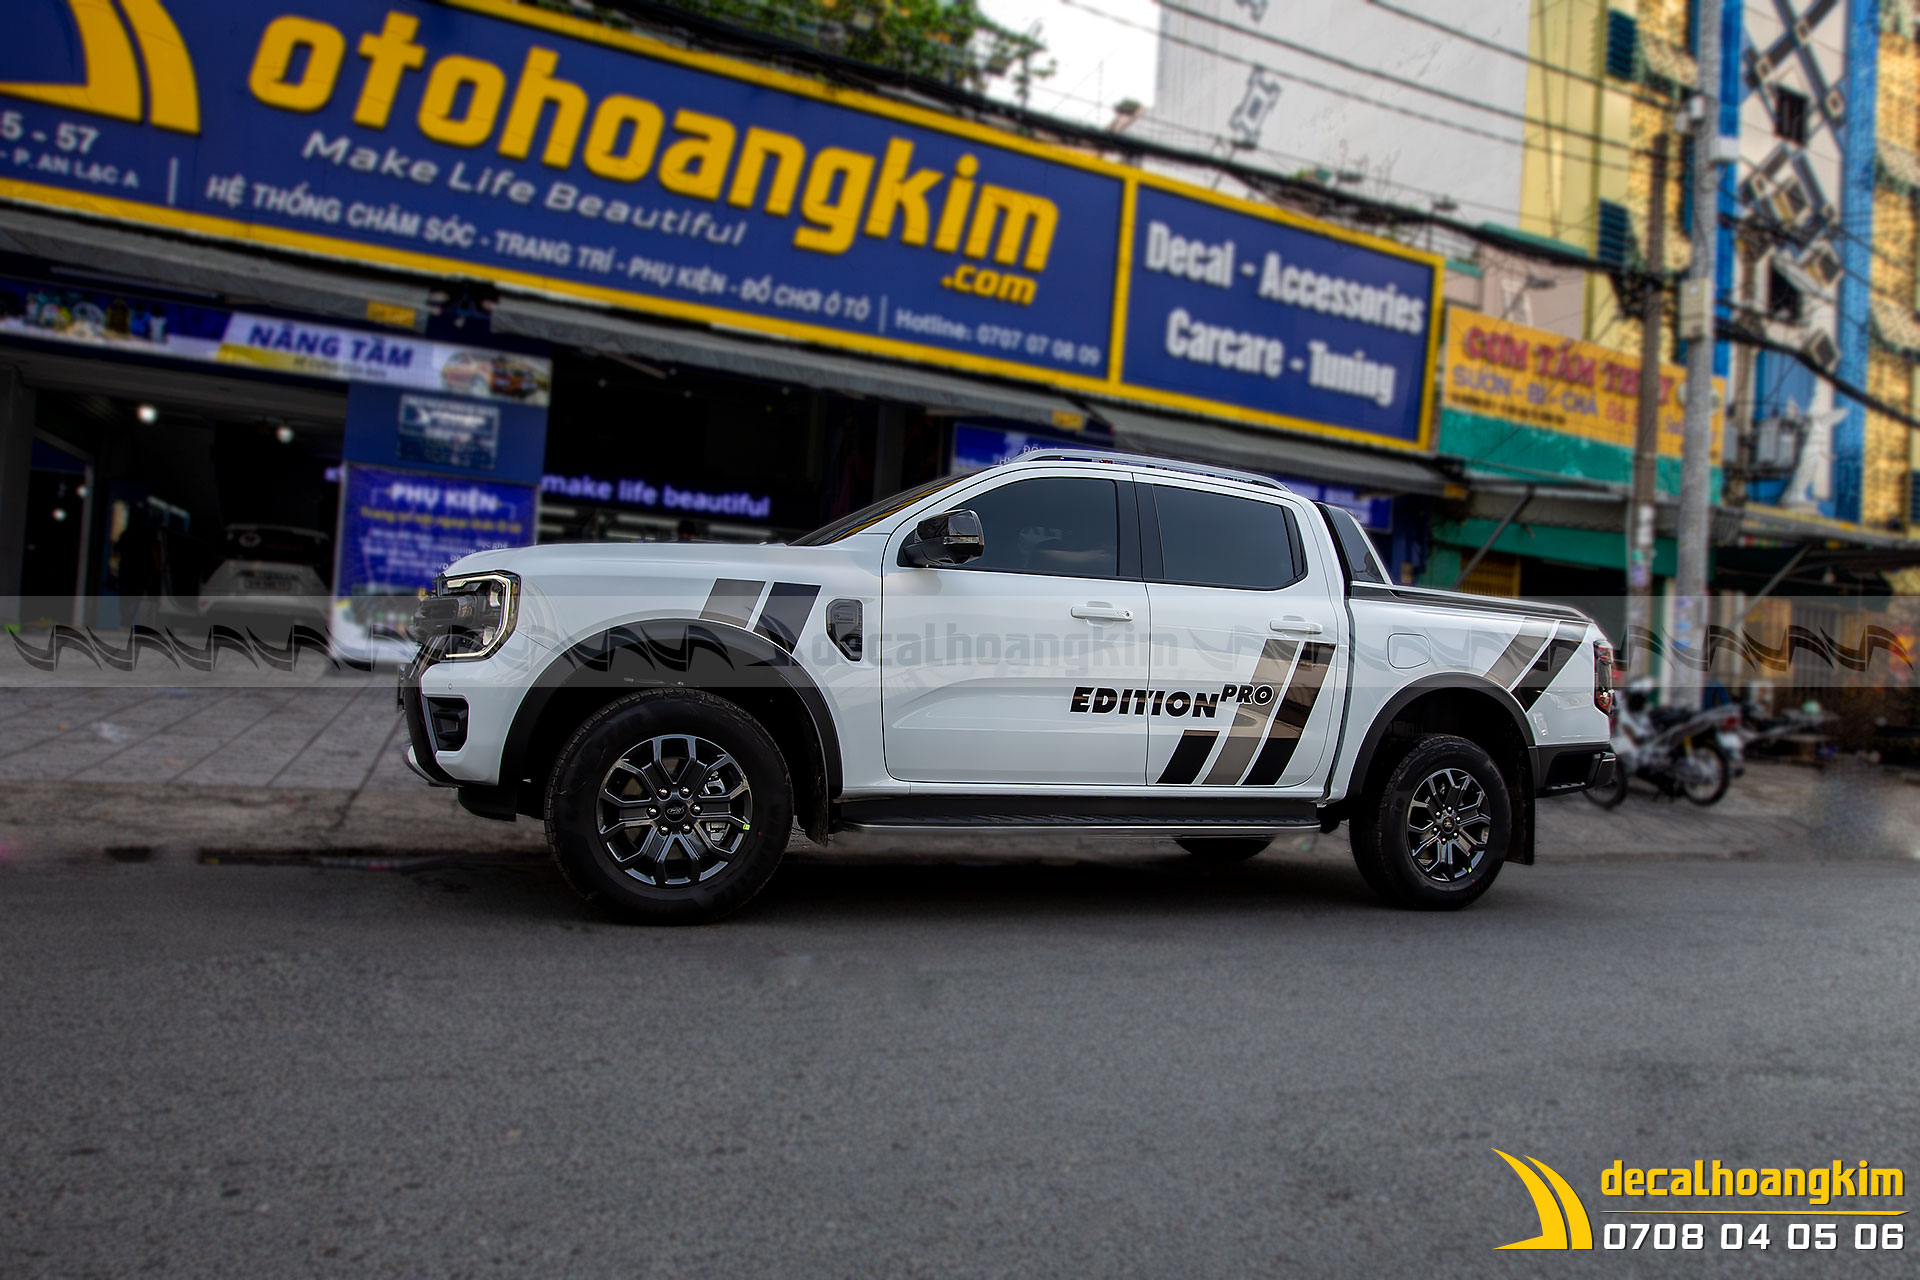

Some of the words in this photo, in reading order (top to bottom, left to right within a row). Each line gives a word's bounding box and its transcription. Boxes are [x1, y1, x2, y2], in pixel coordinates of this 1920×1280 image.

[55, 121, 99, 154] 57
[249, 11, 1058, 271] otohoangkim
[123, 169, 139, 188] A
[303, 132, 438, 183] Make
[448, 161, 536, 205] Life
[544, 181, 746, 246] Beautiful
[206, 174, 246, 208] HỆ
[253, 181, 341, 223] THỐNG
[347, 203, 420, 237] CHĂM
[424, 216, 475, 248] SÓC
[495, 230, 571, 266] TRANG
[576, 247, 616, 273] TRÍ
[628, 256, 673, 288] PHỤ
[676, 266, 727, 294] KIỆN
[940, 264, 1037, 306] .com
[1145, 221, 1234, 287] Decal
[1259, 251, 1424, 335] Accessories
[895, 308, 973, 341] Hotline:
[977, 323, 1022, 350] 0707
[1025, 333, 1049, 355] 07
[1166, 309, 1283, 377] Carcare
[1307, 340, 1396, 406] Tuning
[541, 474, 612, 500] make
[618, 479, 658, 505] life
[663, 484, 770, 517] beautiful
[1069, 685, 1221, 718] EDITION
[1221, 683, 1275, 706] PRO
